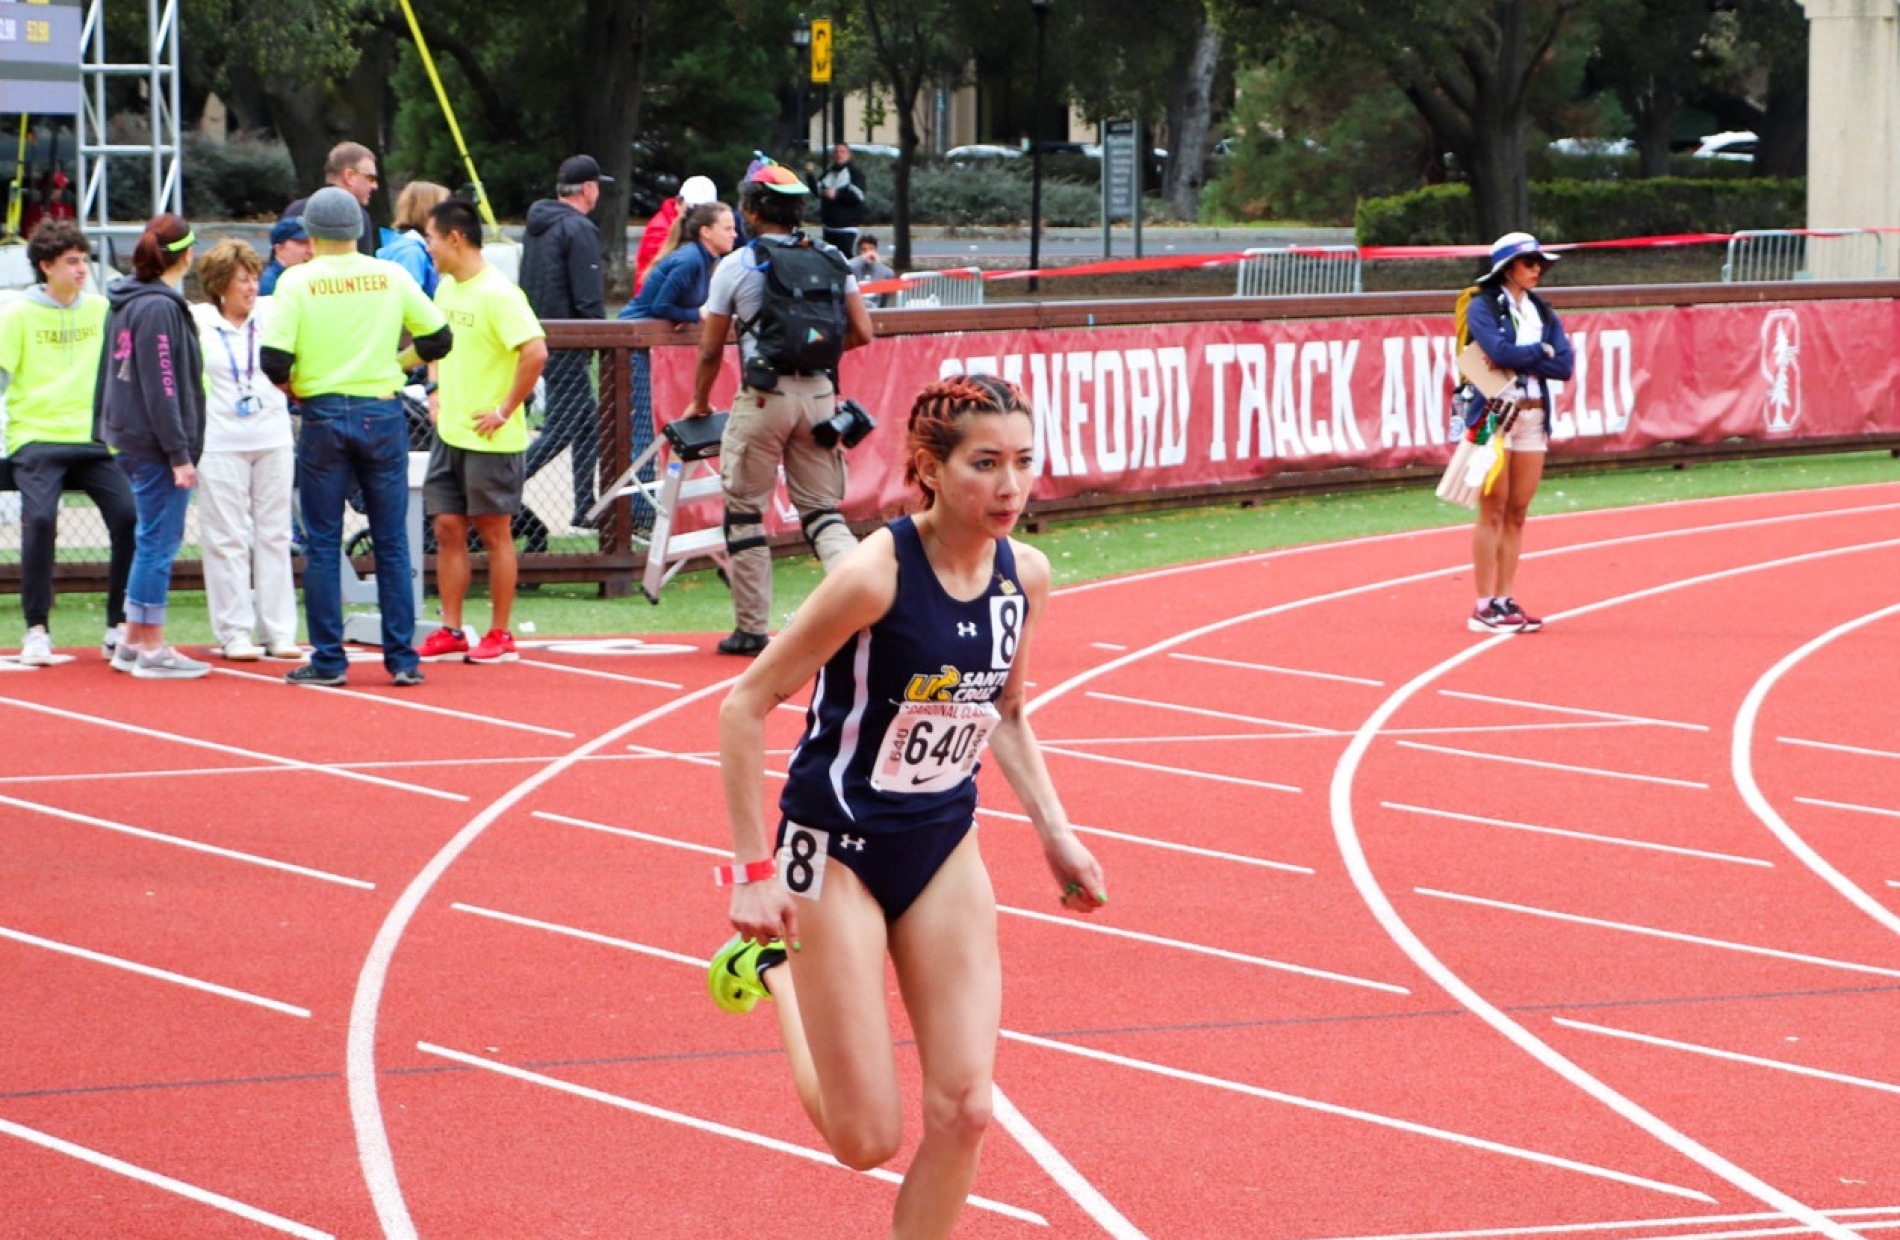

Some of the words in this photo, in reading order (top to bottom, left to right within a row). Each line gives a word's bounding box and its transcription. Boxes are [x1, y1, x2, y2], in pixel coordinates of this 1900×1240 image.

[308, 275, 388, 296] VOLUNTEER
[939, 346, 1191, 477] NFORD
[1205, 340, 1364, 462] TRACK
[1380, 335, 1461, 448] AN
[1000, 600, 1017, 664] 8
[889, 728, 909, 763] 640
[904, 721, 976, 766] 640
[786, 830, 817, 893] 8
